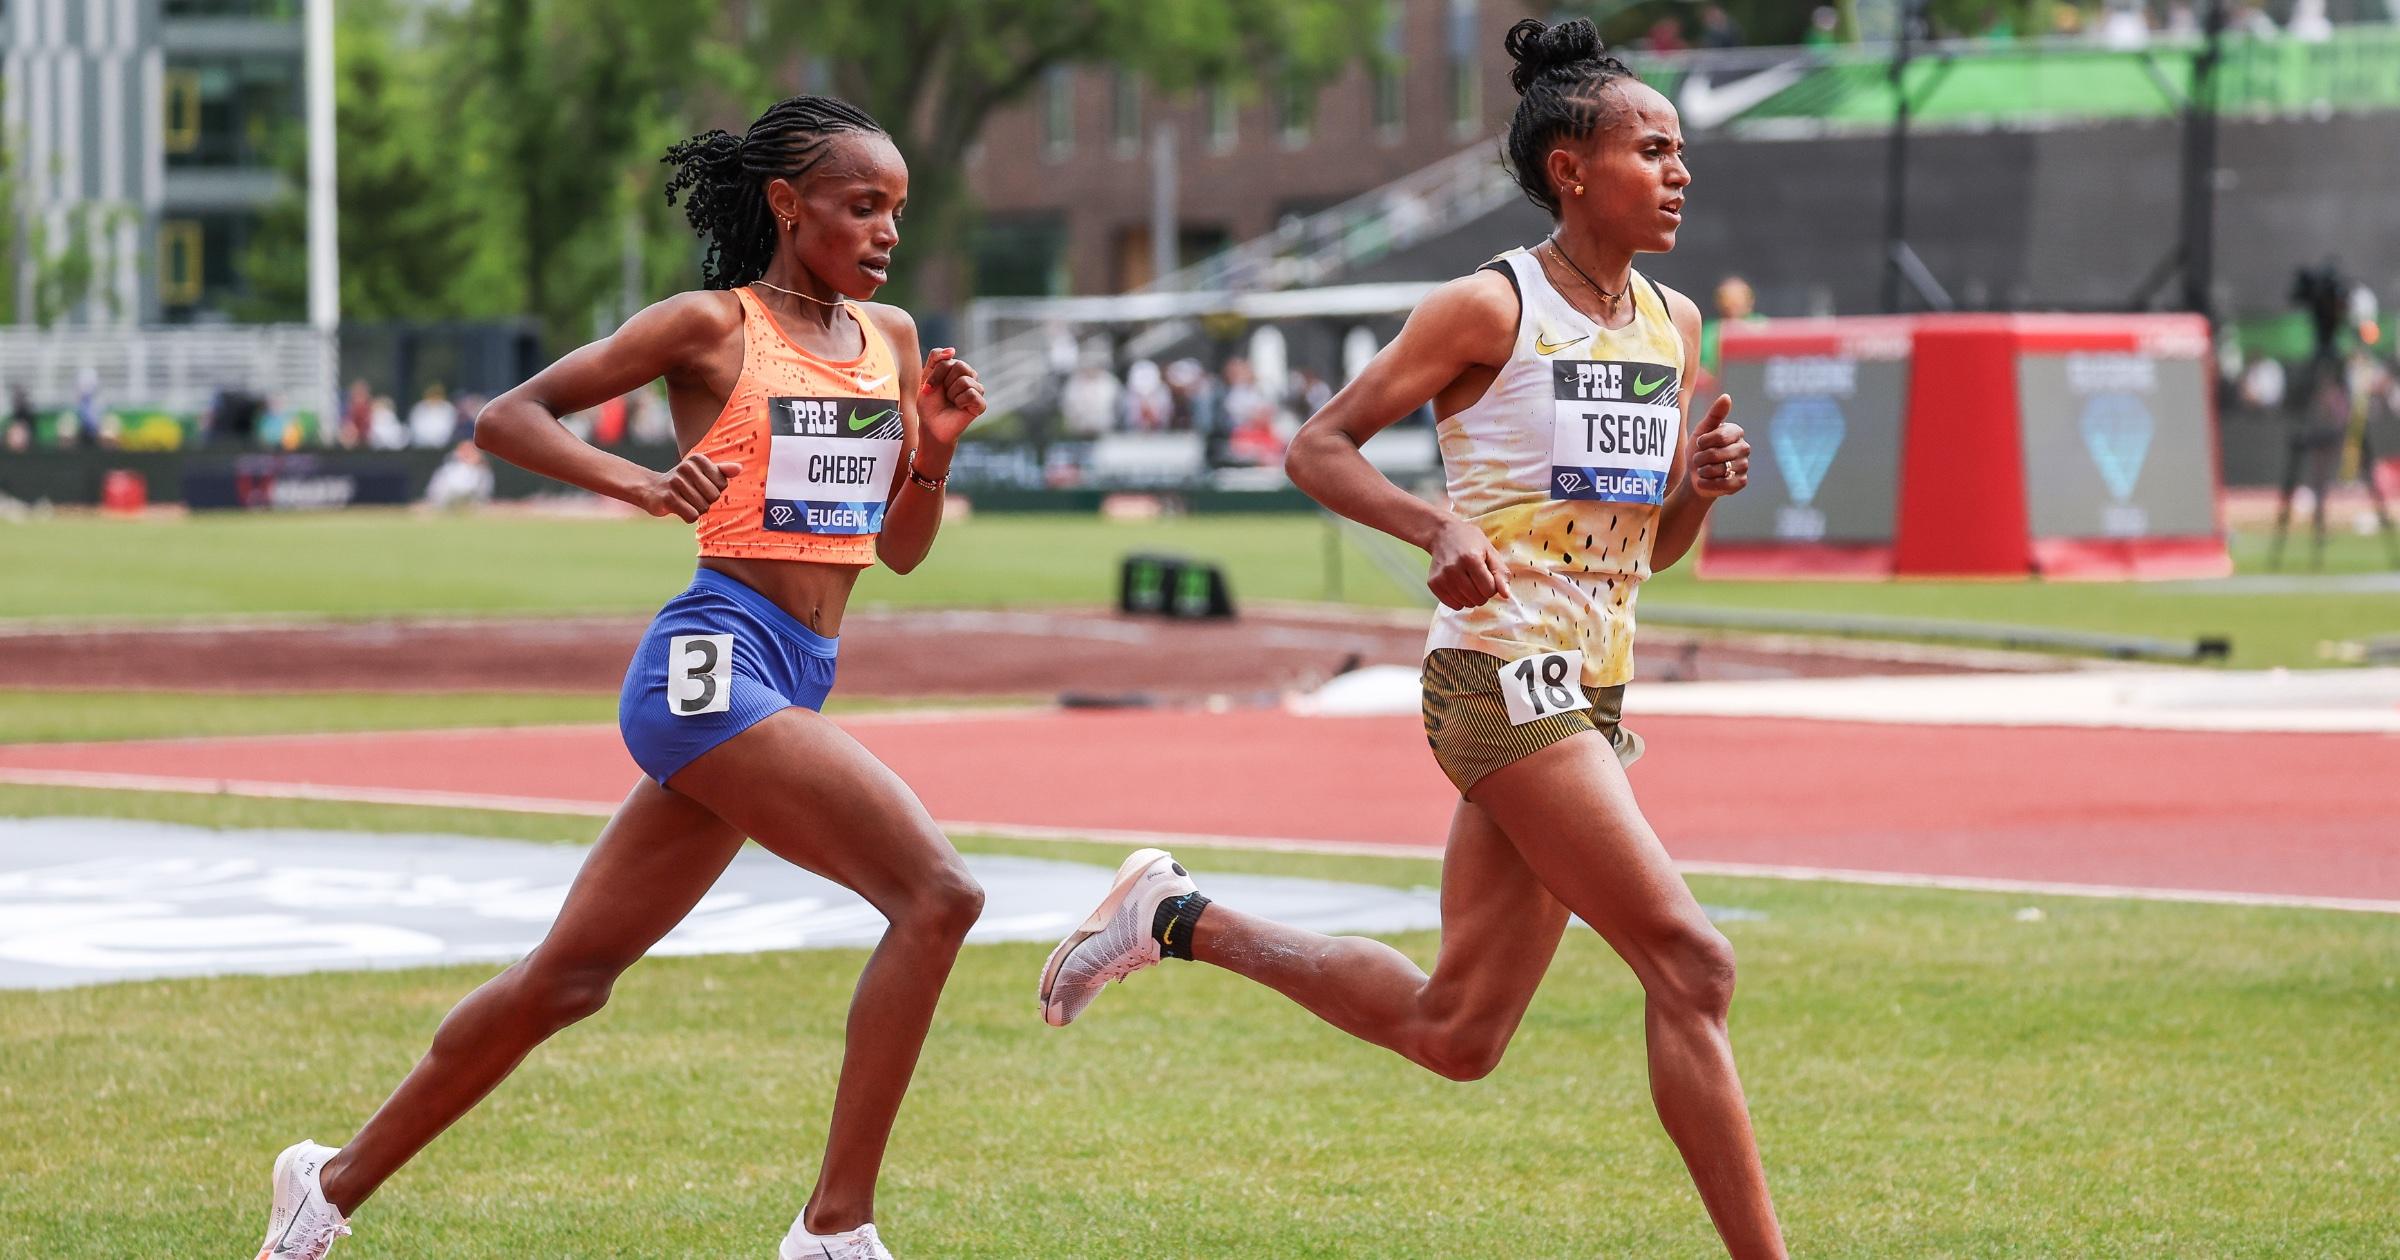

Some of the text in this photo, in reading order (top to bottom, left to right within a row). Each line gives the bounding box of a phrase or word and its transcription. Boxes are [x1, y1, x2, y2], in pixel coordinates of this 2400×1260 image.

[1576, 363, 1622, 399] PRE
[791, 400, 838, 435] PRE
[1582, 413, 1667, 457] TSEGAY
[808, 454, 877, 485] CHEBET
[806, 508, 868, 527] EUGENE
[680, 639, 718, 712] 3
[1514, 654, 1575, 716] 18
